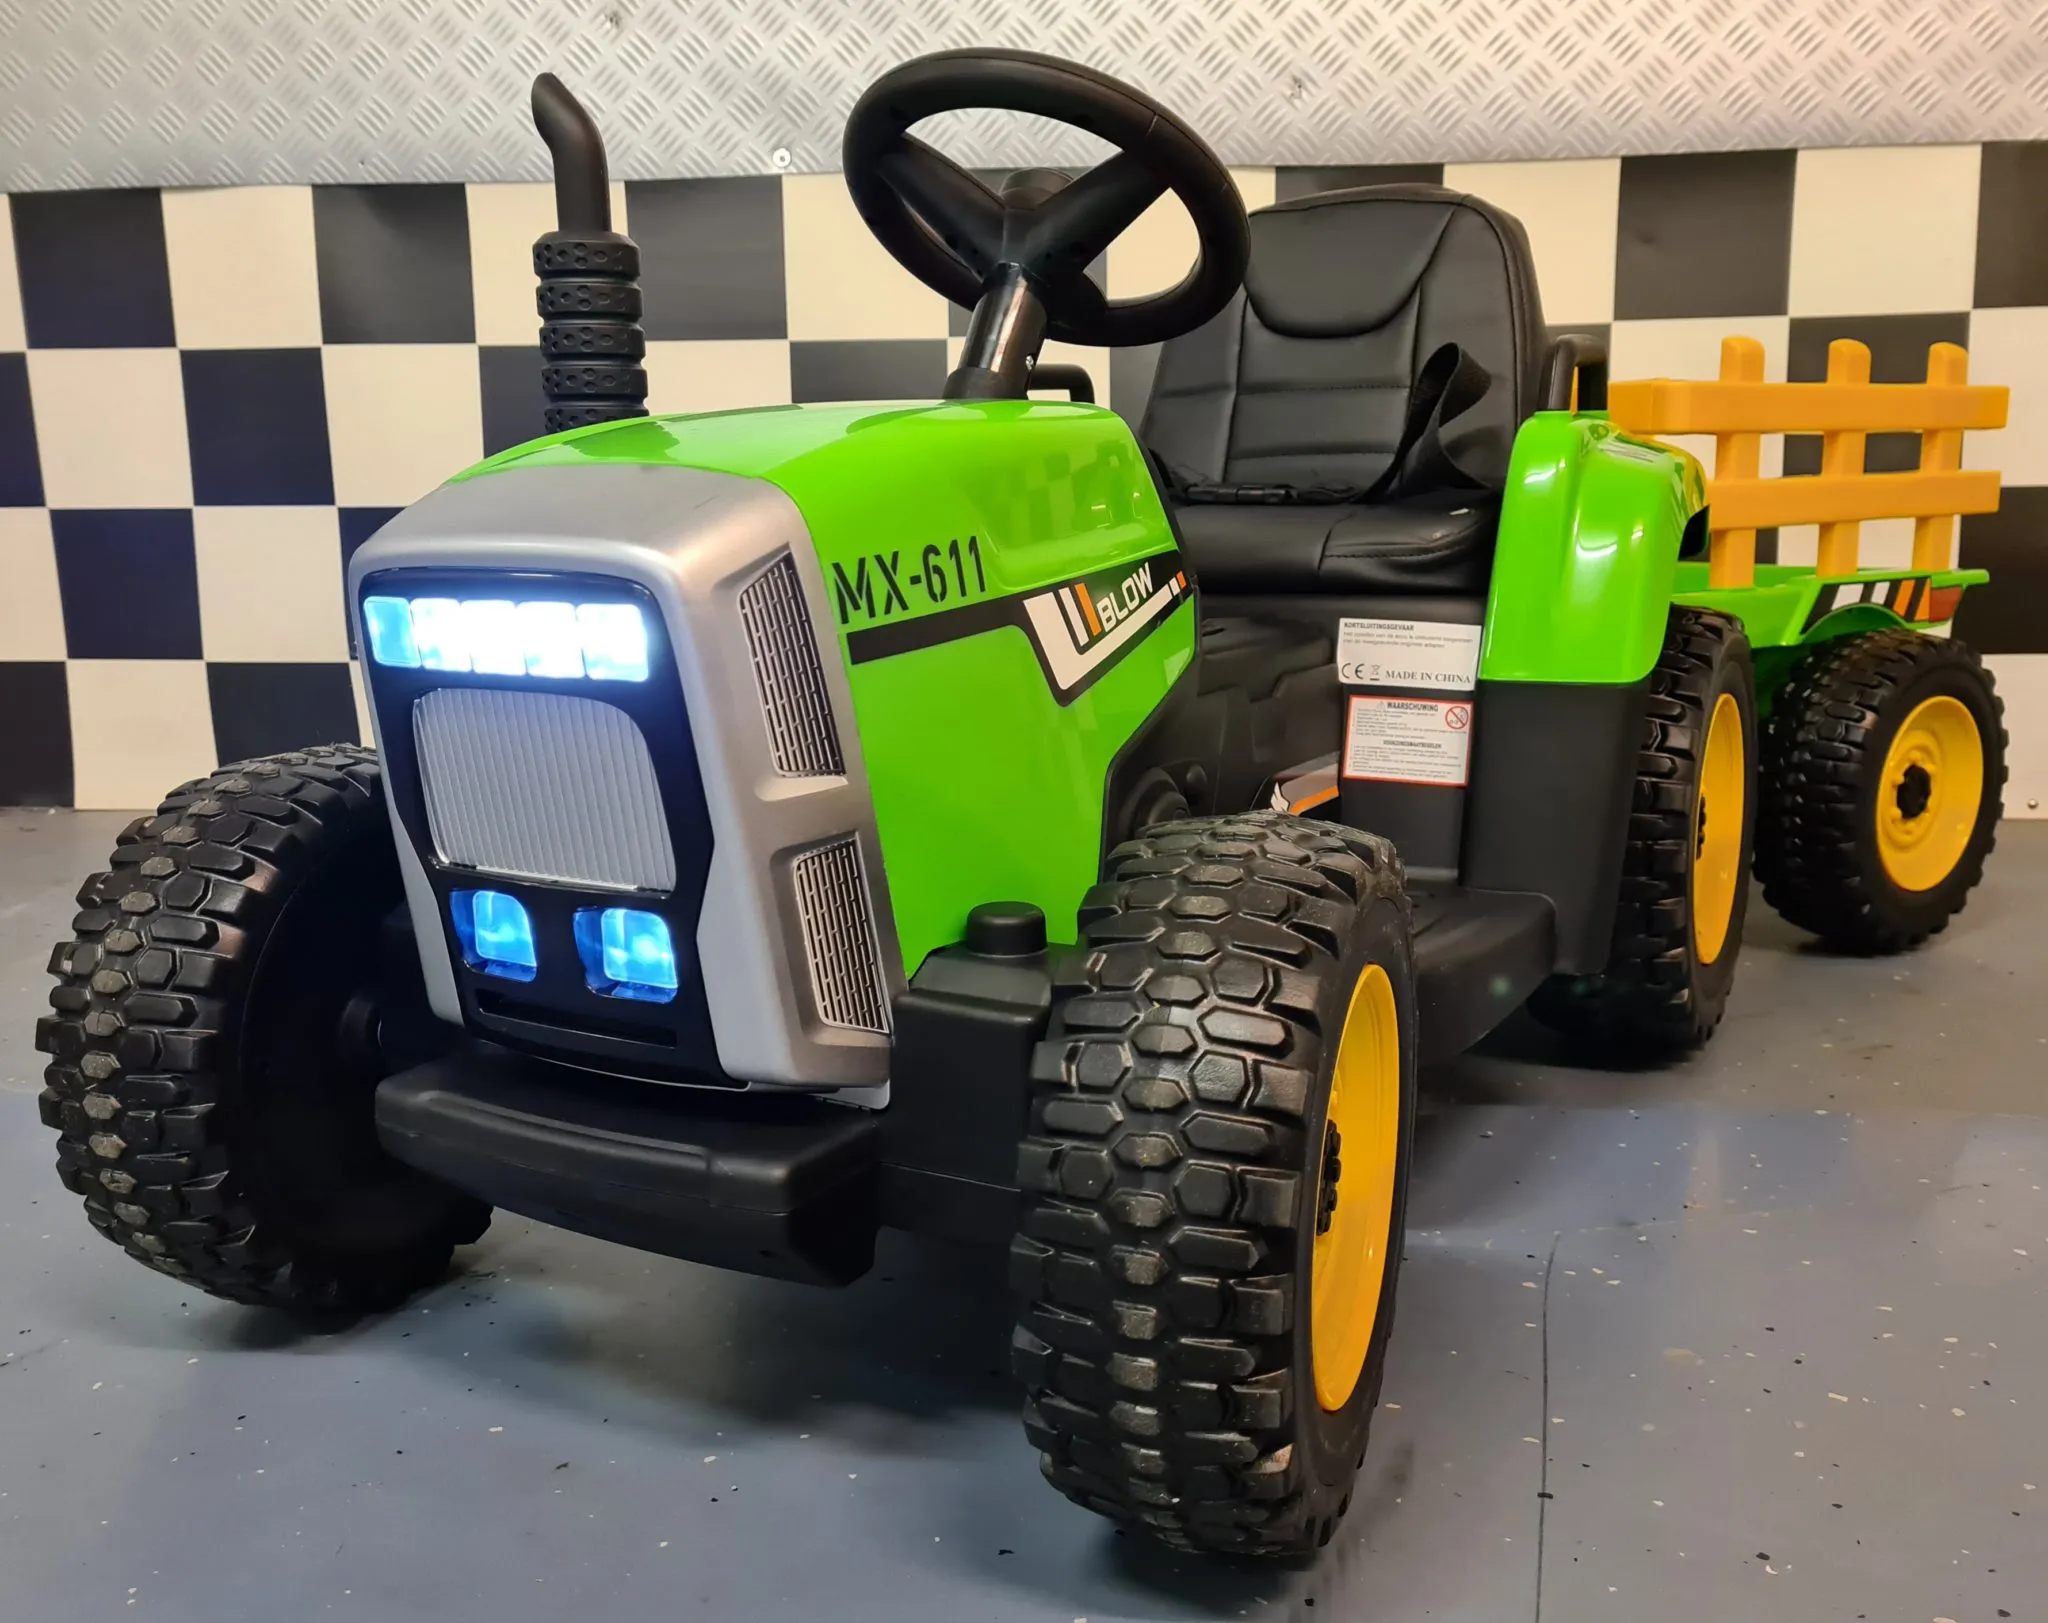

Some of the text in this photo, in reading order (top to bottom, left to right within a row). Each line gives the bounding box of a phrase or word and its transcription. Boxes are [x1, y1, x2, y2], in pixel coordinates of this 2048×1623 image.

[832, 535, 987, 624] MX-611
[1098, 563, 1154, 633] BLOW
[1342, 663, 1365, 680] CE
[1385, 670, 1471, 684] MADE IN CHINA
[1387, 702, 1438, 712] WAARSCHUWING
